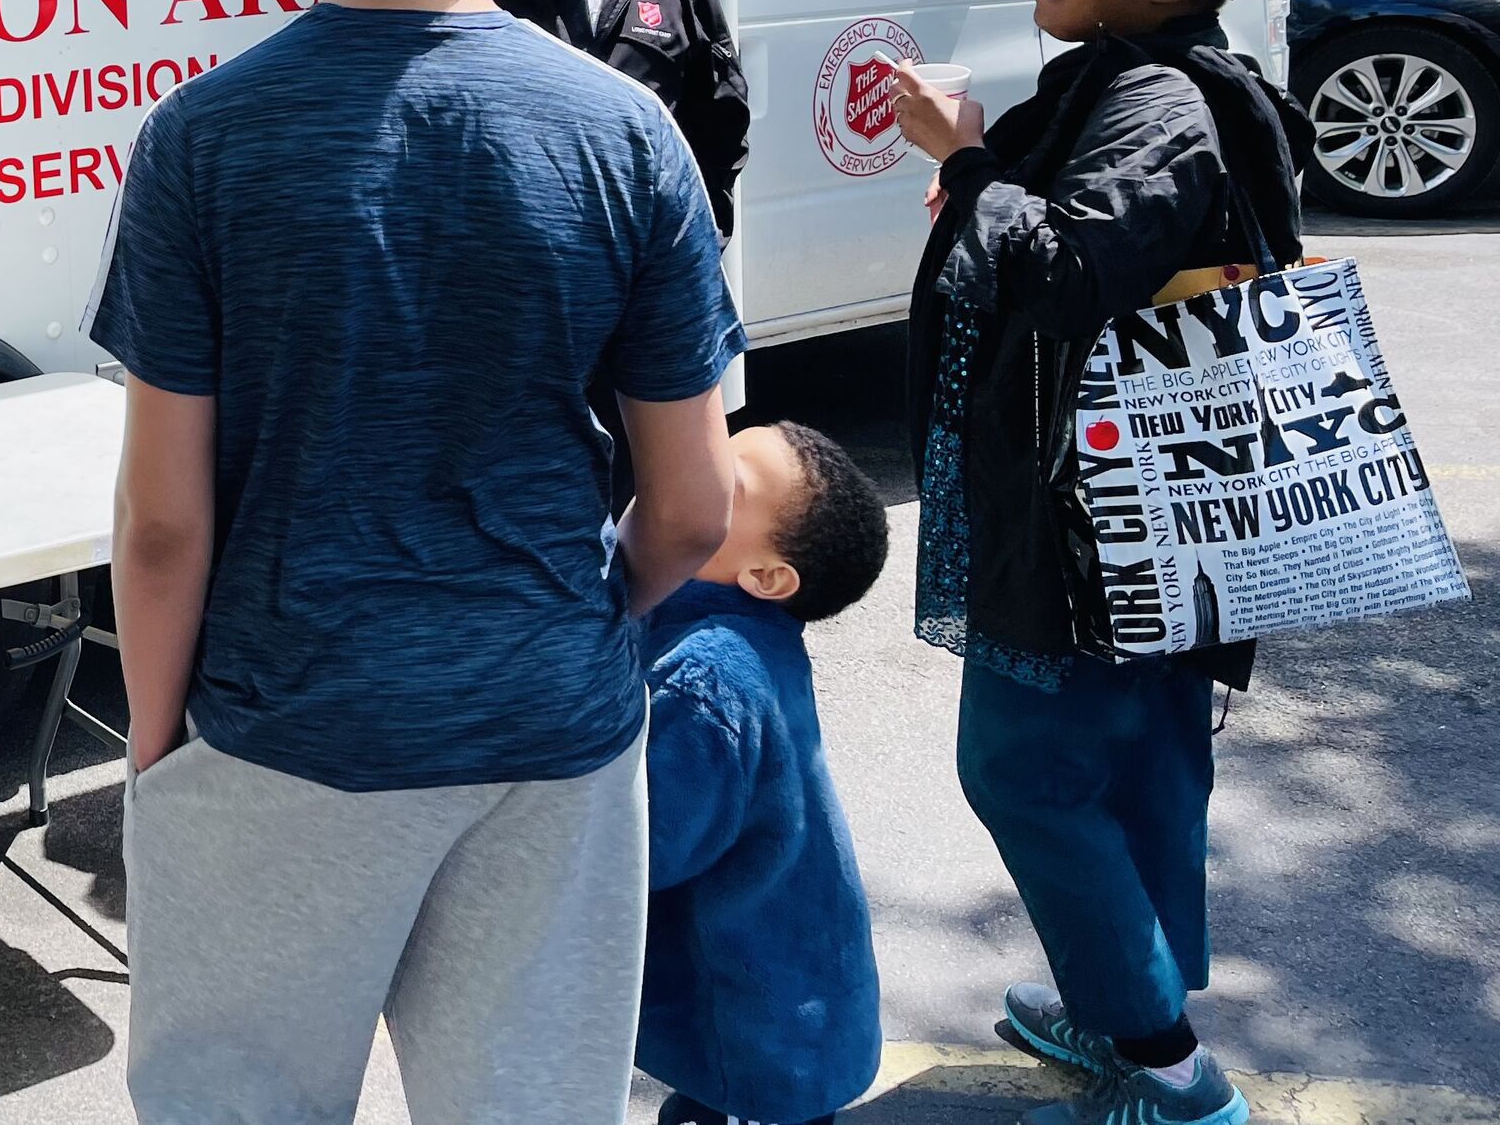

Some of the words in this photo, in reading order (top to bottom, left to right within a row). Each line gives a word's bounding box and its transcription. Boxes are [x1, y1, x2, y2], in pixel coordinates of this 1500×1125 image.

[819, 23, 878, 90] EMERGENCY
[886, 25, 923, 65] DISAST
[847, 68, 898, 123] SALVATION
[855, 64, 878, 93] THE
[863, 99, 893, 134] ARMY
[840, 149, 896, 172] SERVICES
[1291, 272, 1350, 333] NYC
[1114, 273, 1301, 376] NYC
[1281, 335, 1327, 359] YORK
[1327, 328, 1352, 348] CITY
[1120, 376, 1158, 394] THE
[1162, 371, 1194, 388] BIG
[1200, 358, 1248, 384] APPLE
[1280, 362, 1308, 379] CITY
[1124, 393, 1165, 410] NEW
[1168, 387, 1214, 404] YORK
[1218, 379, 1251, 396] CITY
[1190, 399, 1260, 432] YORK
[1268, 382, 1316, 415] CITY
[1136, 440, 1161, 497] YORK
[1168, 482, 1214, 497] NEW
[1219, 475, 1266, 493] YORK
[1269, 463, 1302, 483] CITY
[1305, 454, 1337, 473] THE
[1340, 446, 1369, 464] BIG
[1077, 451, 1148, 544] CITY
[1148, 504, 1172, 548] NEW
[1170, 493, 1261, 545] NEW
[1222, 549, 1238, 558] The
[1242, 547, 1256, 556] Big
[1259, 542, 1281, 553] Apple
[1292, 533, 1317, 545] Empire
[1224, 561, 1244, 570] That
[1247, 557, 1270, 568] Never
[1159, 556, 1184, 613] YORK
[1226, 573, 1243, 583] City
[1304, 554, 1331, 567] Named
[1228, 585, 1258, 594] Golden
[1260, 577, 1290, 589] Dreams
